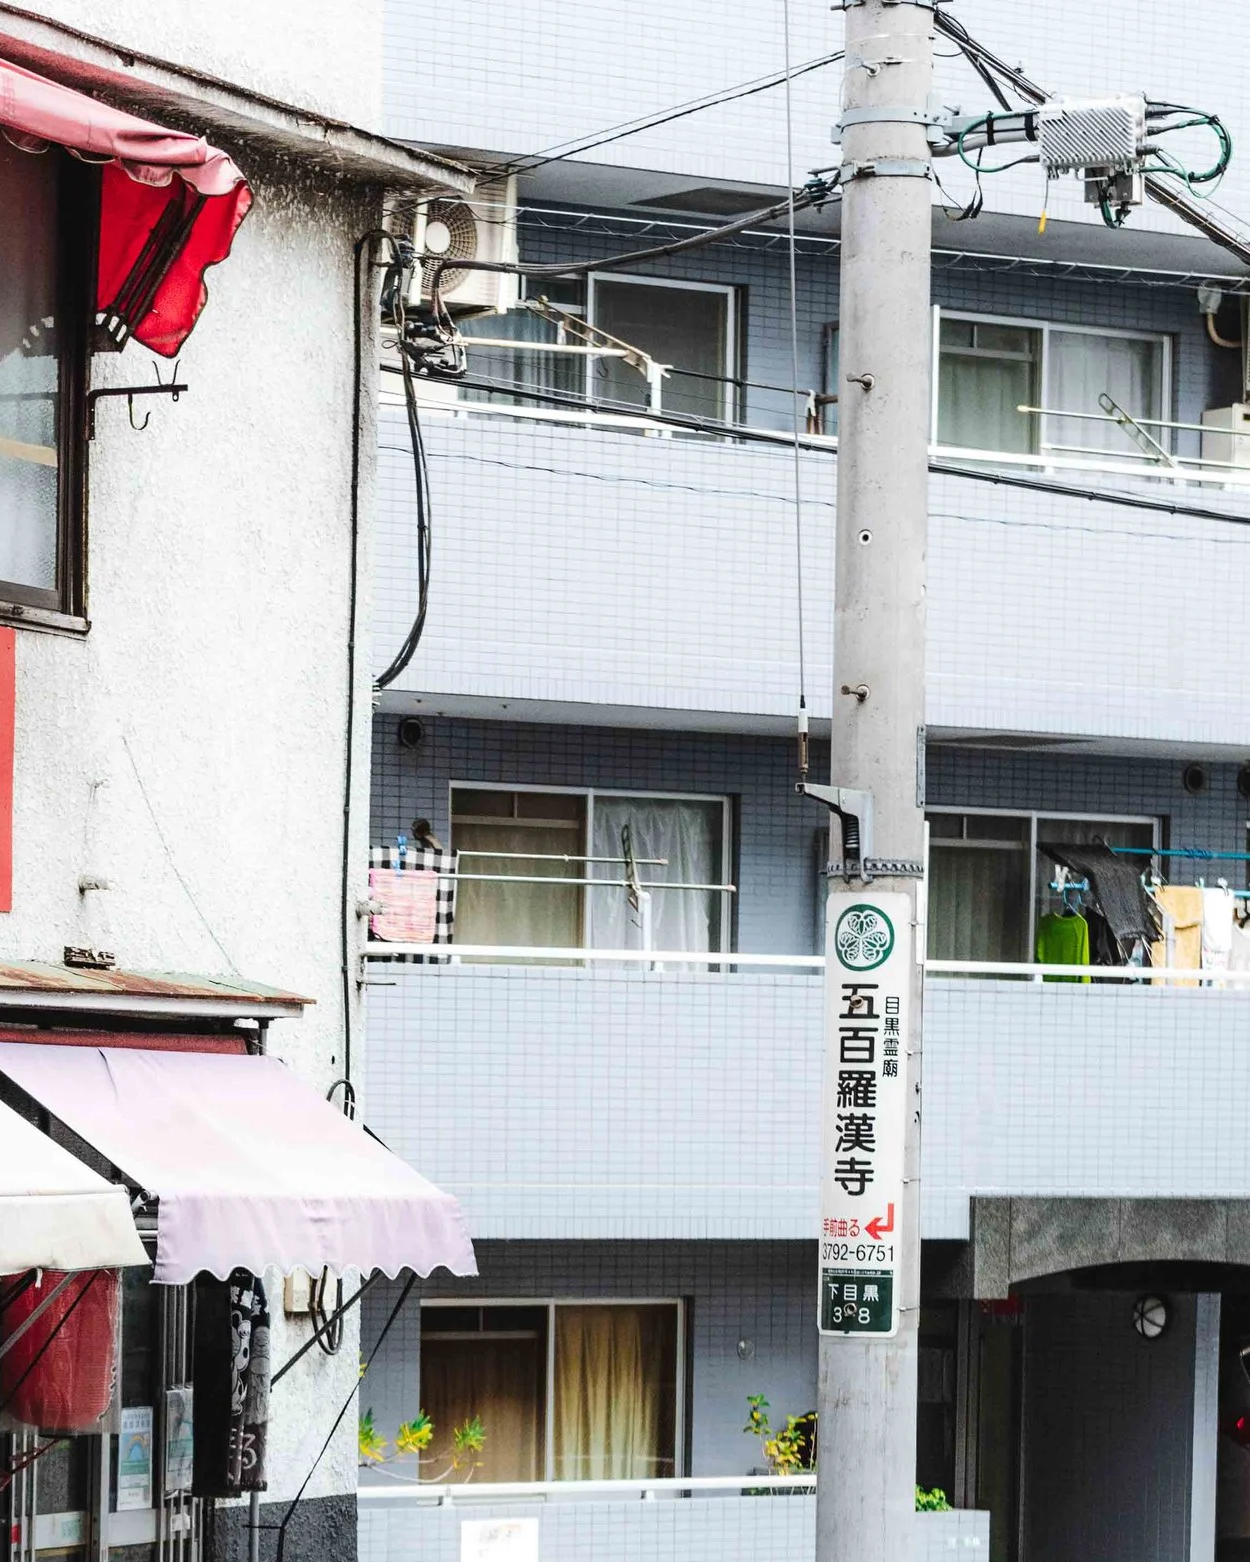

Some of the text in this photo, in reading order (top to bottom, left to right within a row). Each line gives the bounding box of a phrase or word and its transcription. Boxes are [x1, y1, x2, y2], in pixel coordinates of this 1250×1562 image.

[882, 996, 900, 1078] 目黒霊廟
[833, 983, 880, 1197] 五百羅漢寺
[822, 1243, 895, 1262] 3792-6751
[827, 1283, 880, 1302] 下目黒
